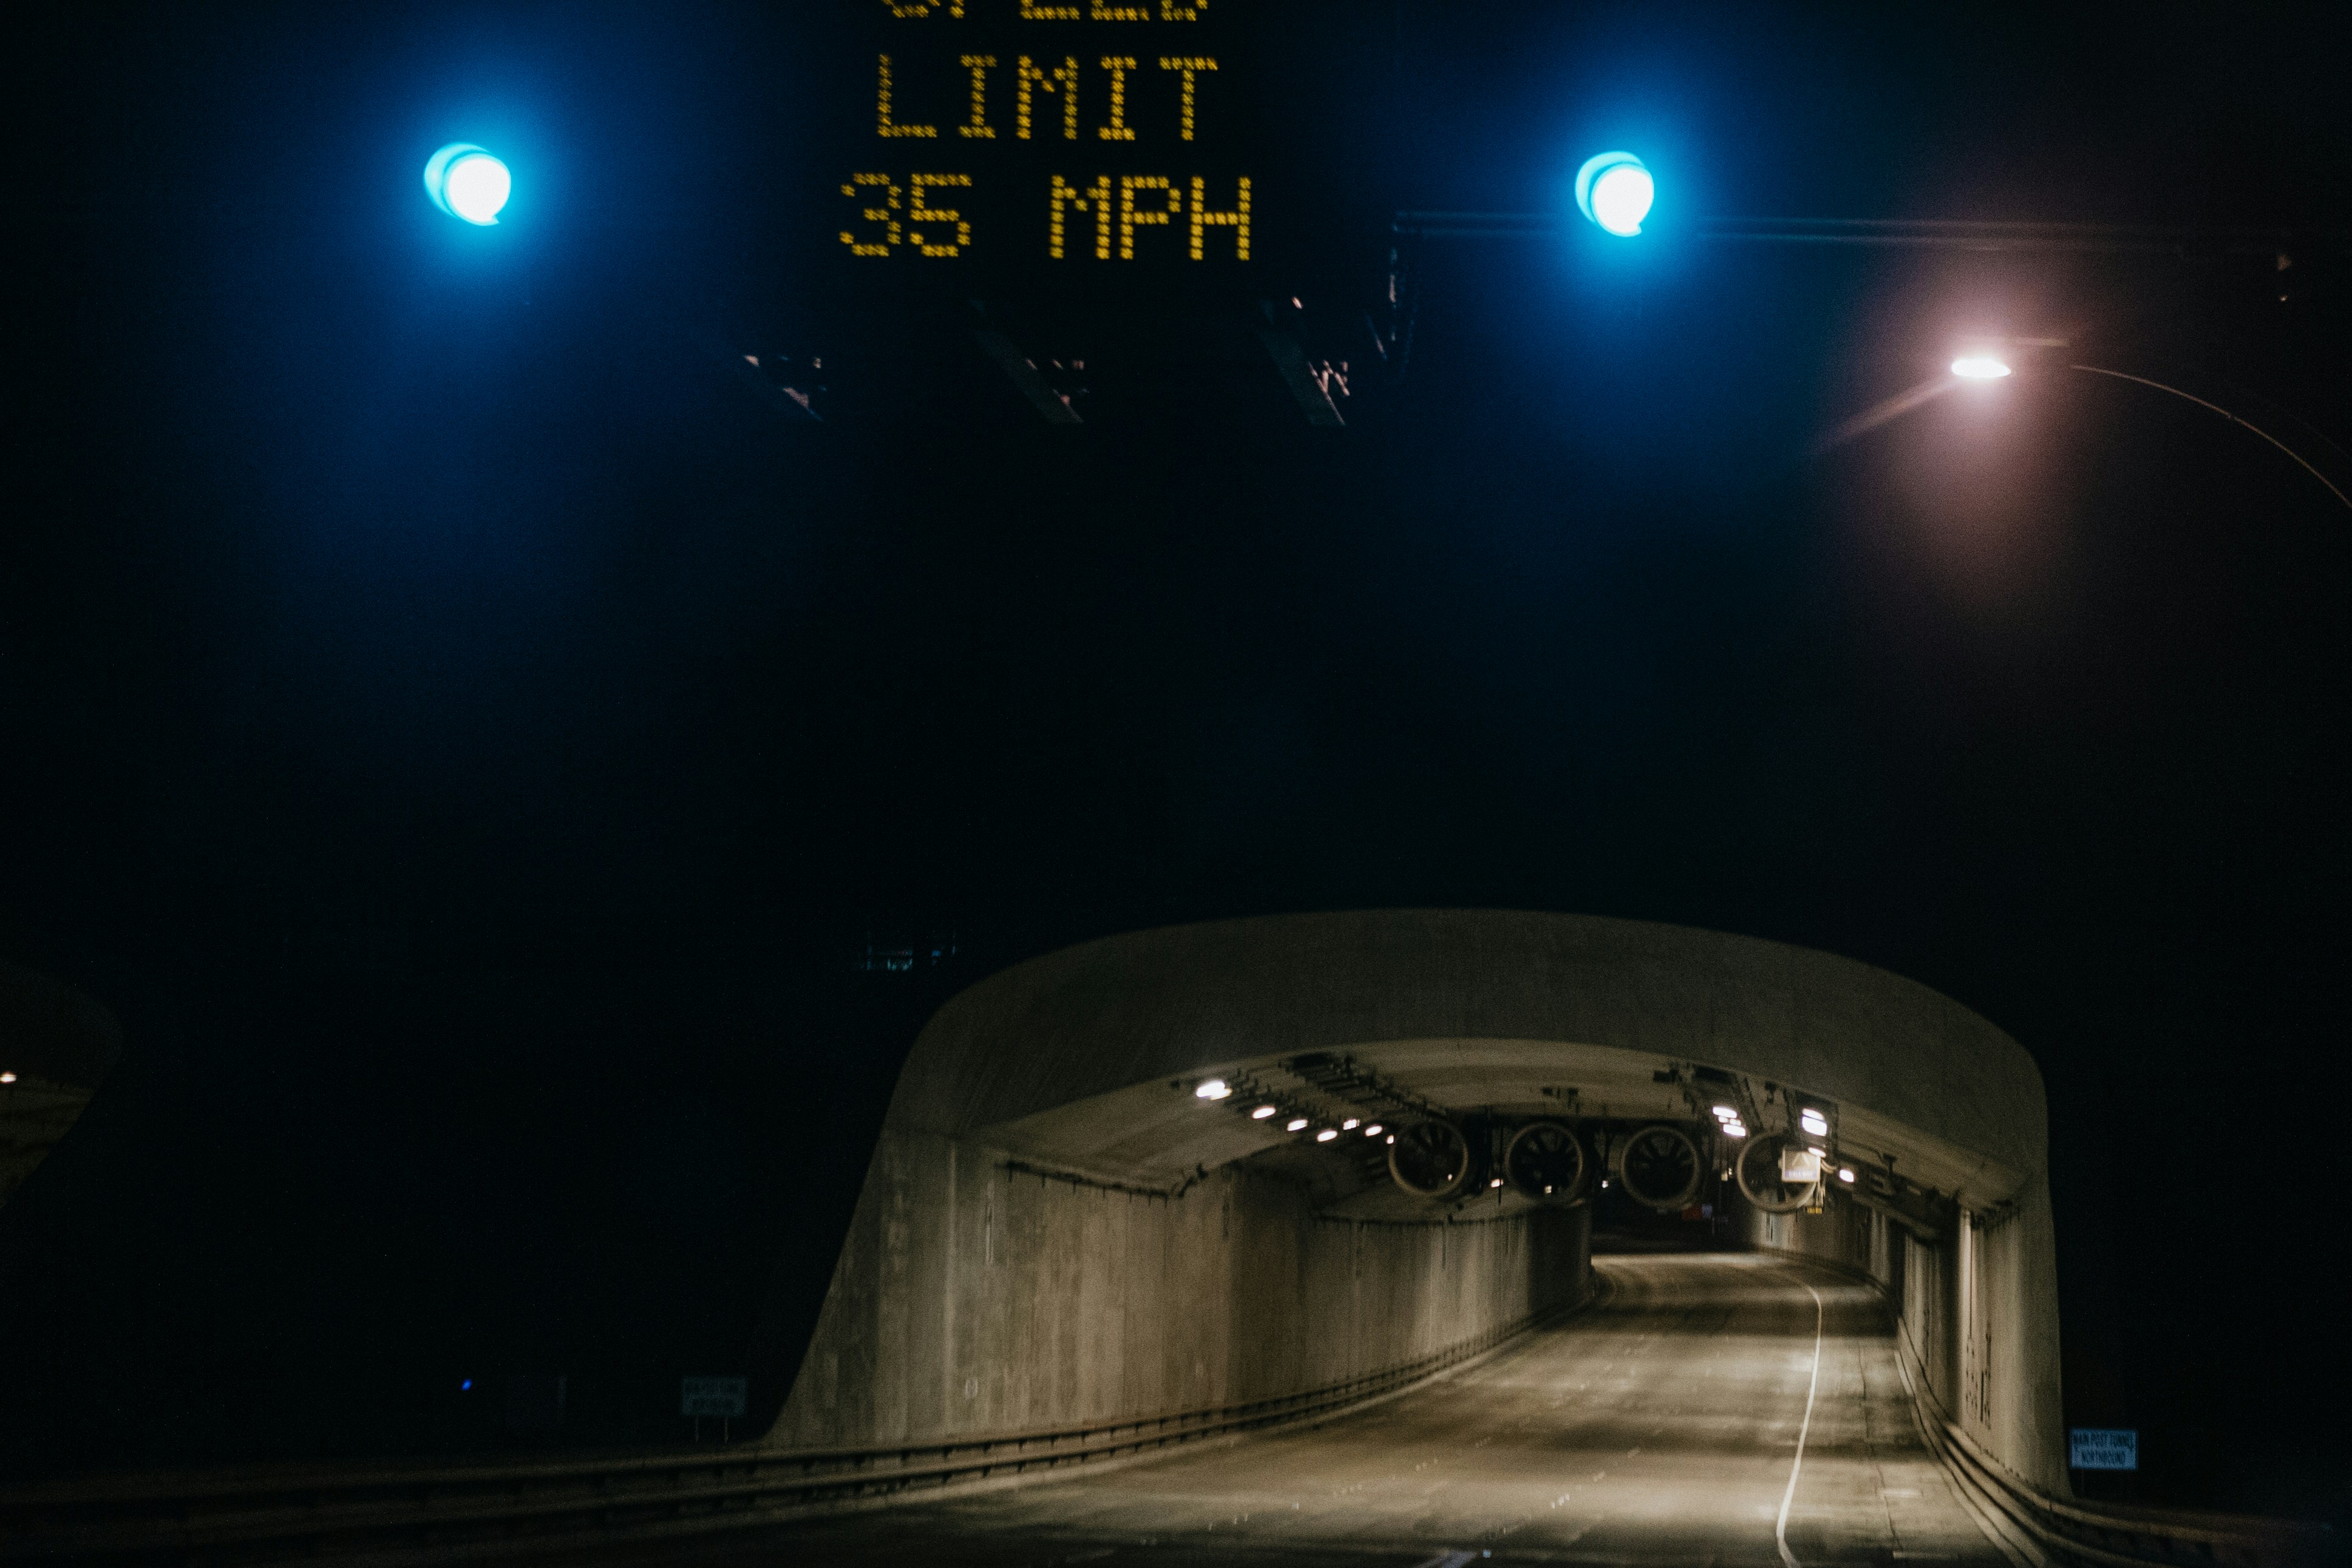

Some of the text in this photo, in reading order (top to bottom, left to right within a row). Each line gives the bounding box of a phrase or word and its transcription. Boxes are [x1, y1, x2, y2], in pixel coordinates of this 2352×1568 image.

[877, 54, 1218, 140] LIMIT
[839, 173, 1251, 260] 35 MPH
